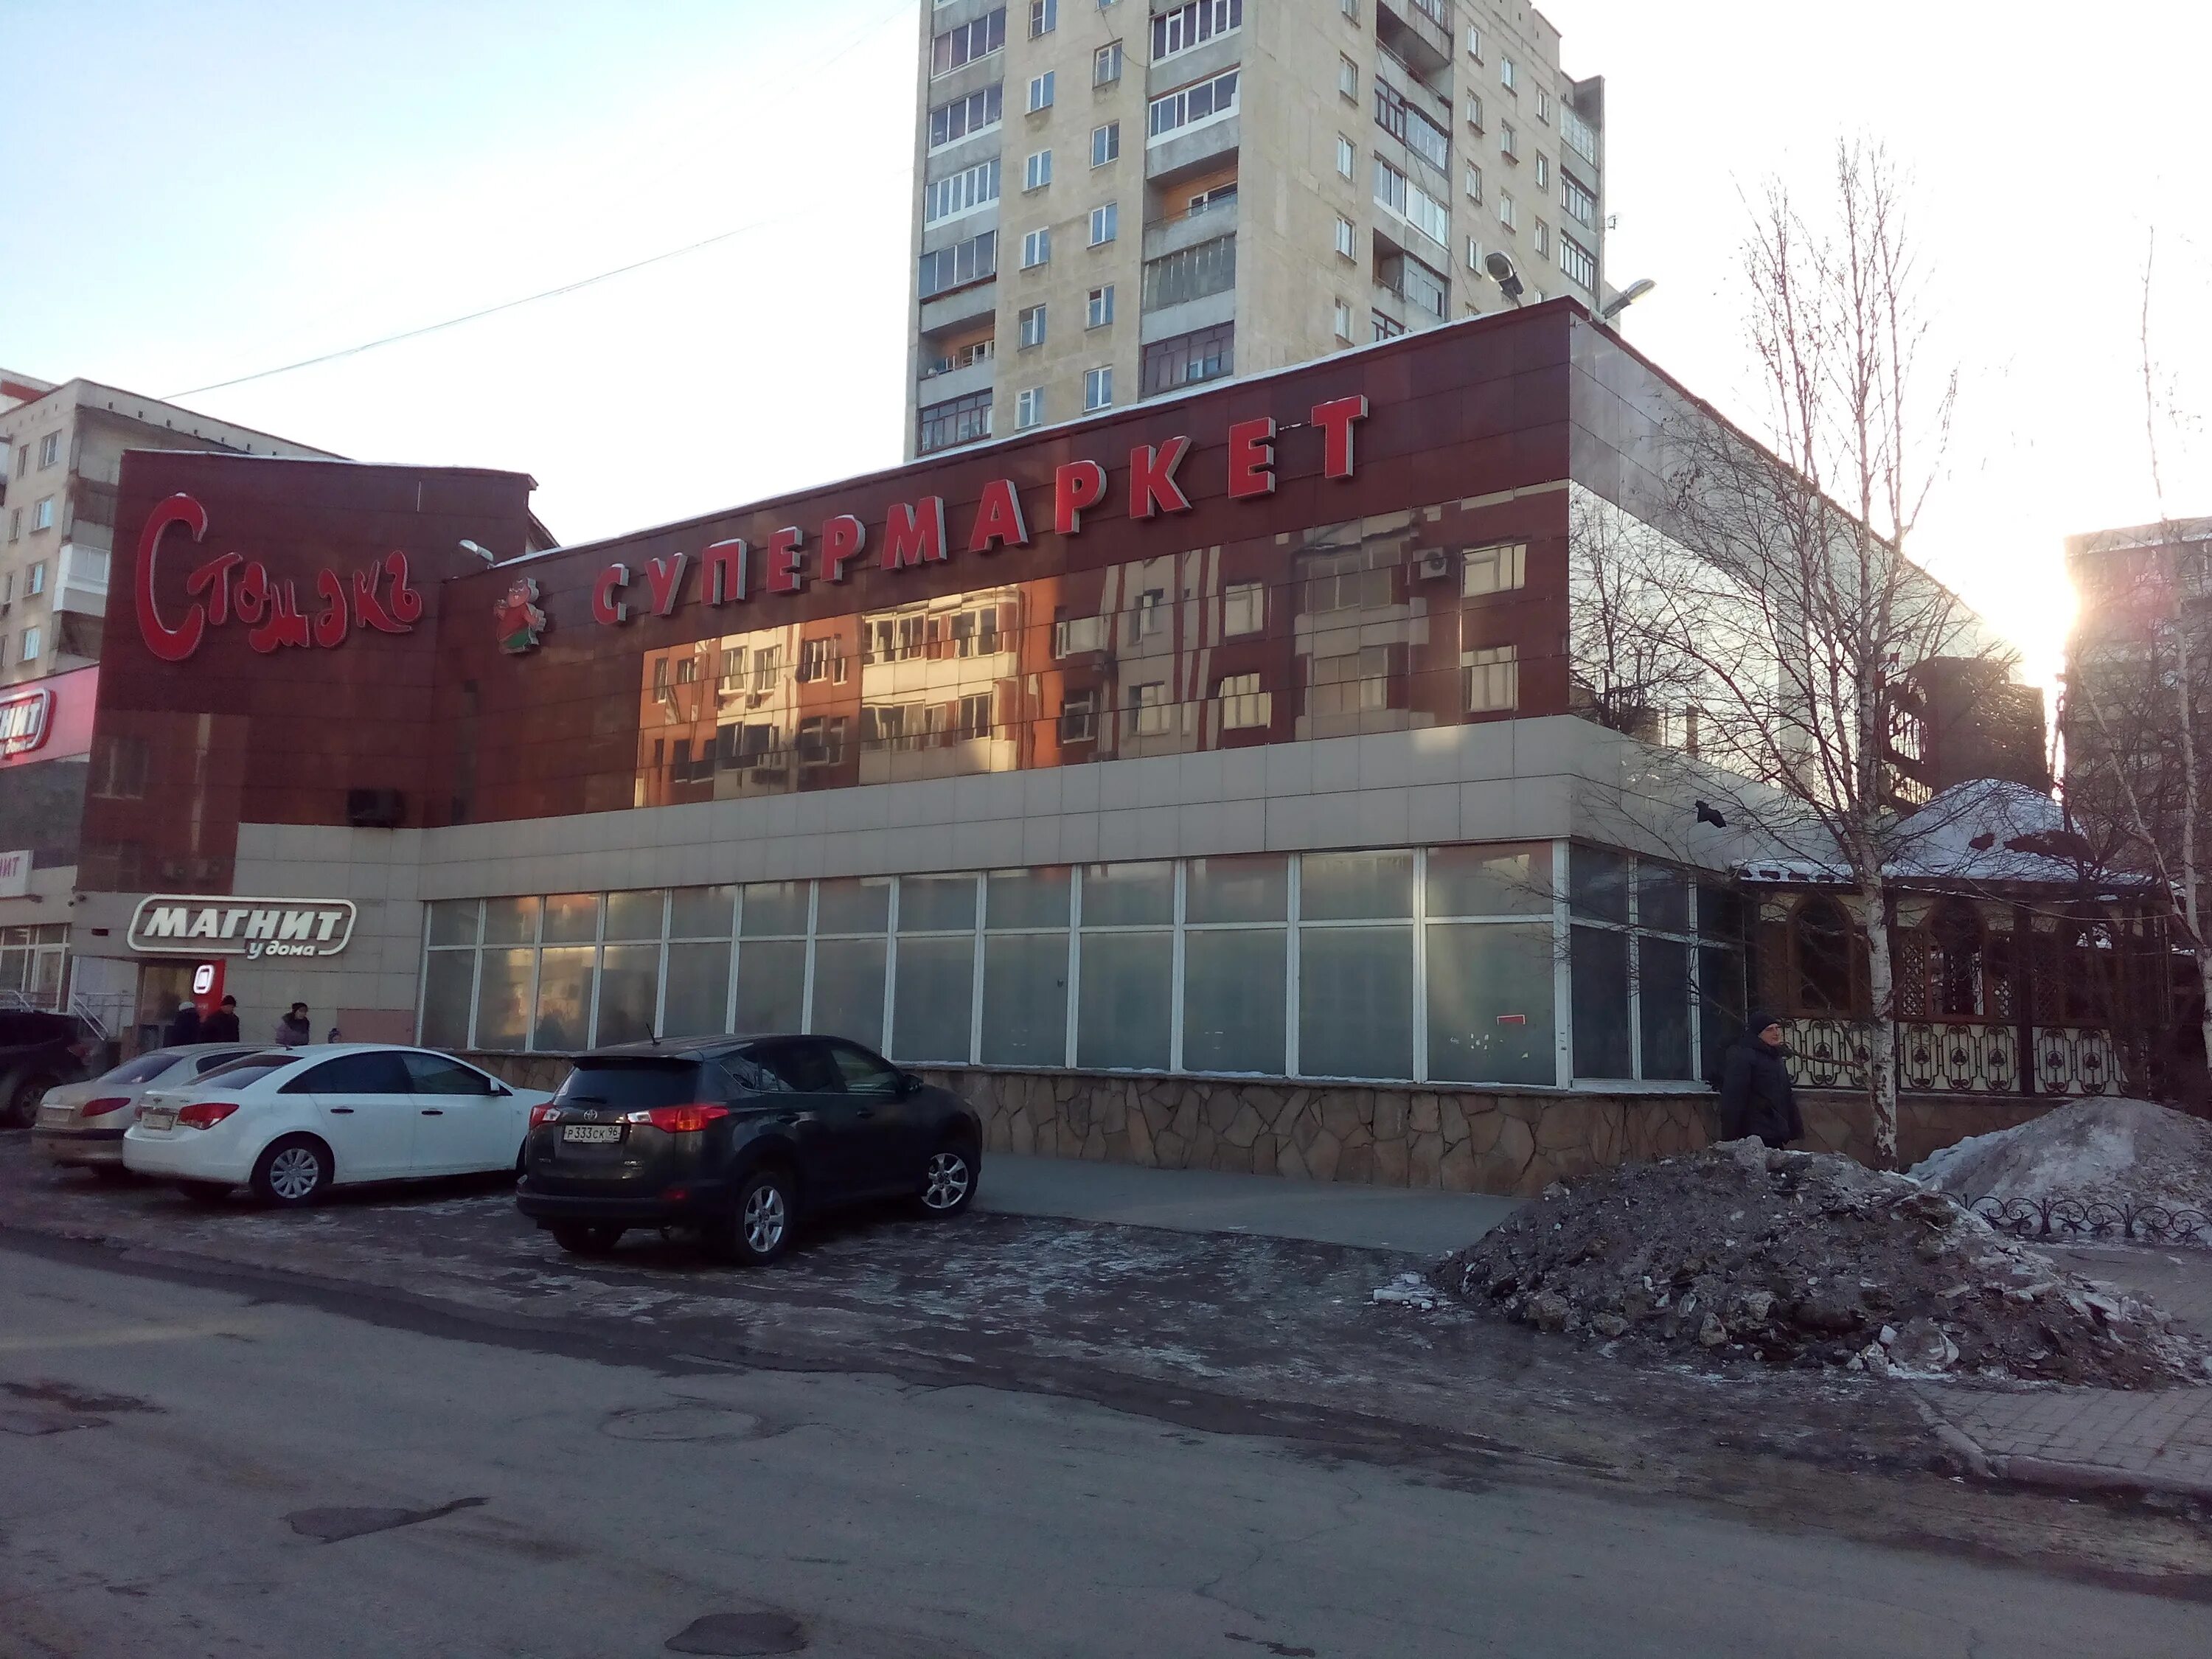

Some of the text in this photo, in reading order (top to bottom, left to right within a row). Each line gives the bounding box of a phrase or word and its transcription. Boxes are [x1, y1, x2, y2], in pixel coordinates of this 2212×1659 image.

[592, 394, 1369, 625] СУПЕРМАРКЕТ
[0, 702, 41, 740] НИТ
[144, 907, 342, 941] МАГНИТ
[247, 940, 316, 959] у дома
